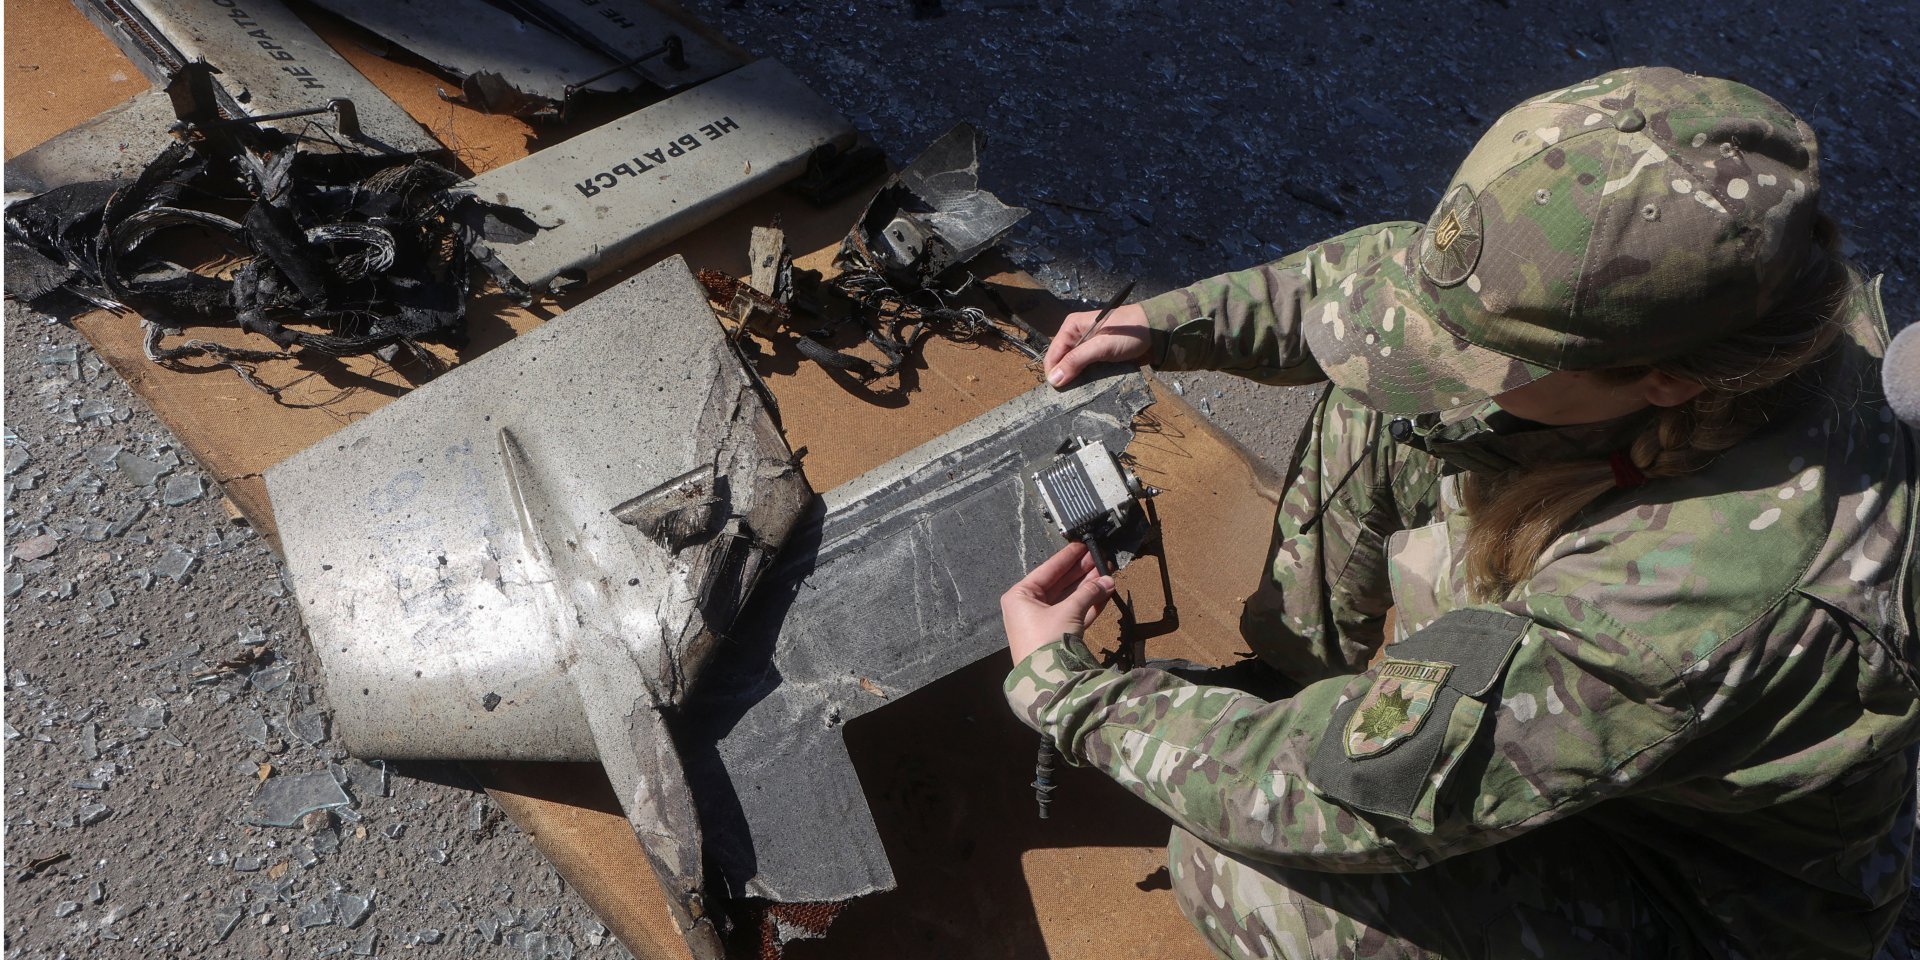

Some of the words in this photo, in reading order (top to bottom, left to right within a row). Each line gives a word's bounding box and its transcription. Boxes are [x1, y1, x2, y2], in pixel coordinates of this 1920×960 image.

[598, 8, 635, 29] НЕ
[281, 65, 326, 89] НЕ
[698, 116, 740, 141] НЕ
[574, 133, 702, 199] БРАТЬСЯ
[1383, 663, 1440, 680] ПОЛІЦІЯ
